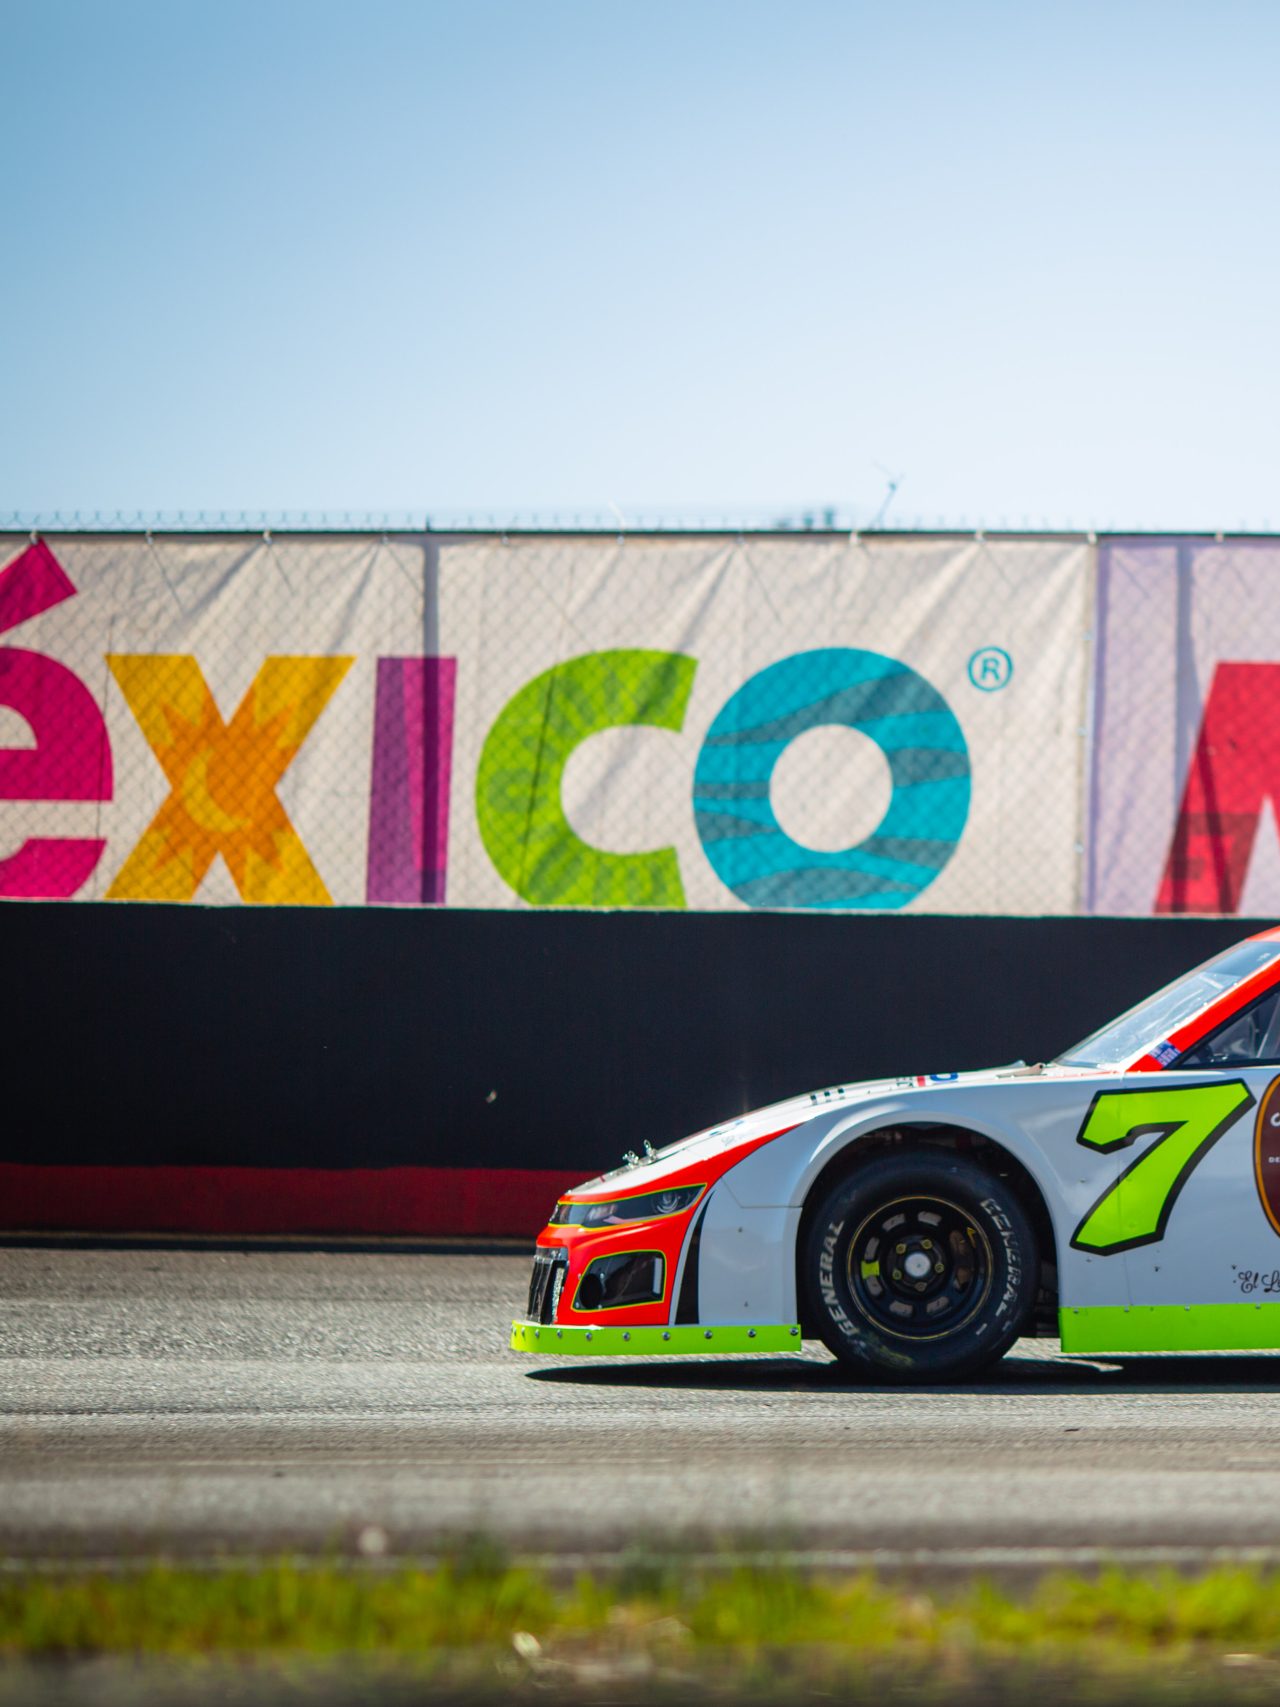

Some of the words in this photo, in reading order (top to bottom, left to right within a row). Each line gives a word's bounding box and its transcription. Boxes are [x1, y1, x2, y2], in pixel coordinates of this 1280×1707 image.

[1069, 1077, 1258, 1257] 7
[820, 1219, 861, 1337] GENERAL
[980, 1198, 1022, 1318] GENERAL
[1238, 1270, 1259, 1294] El
